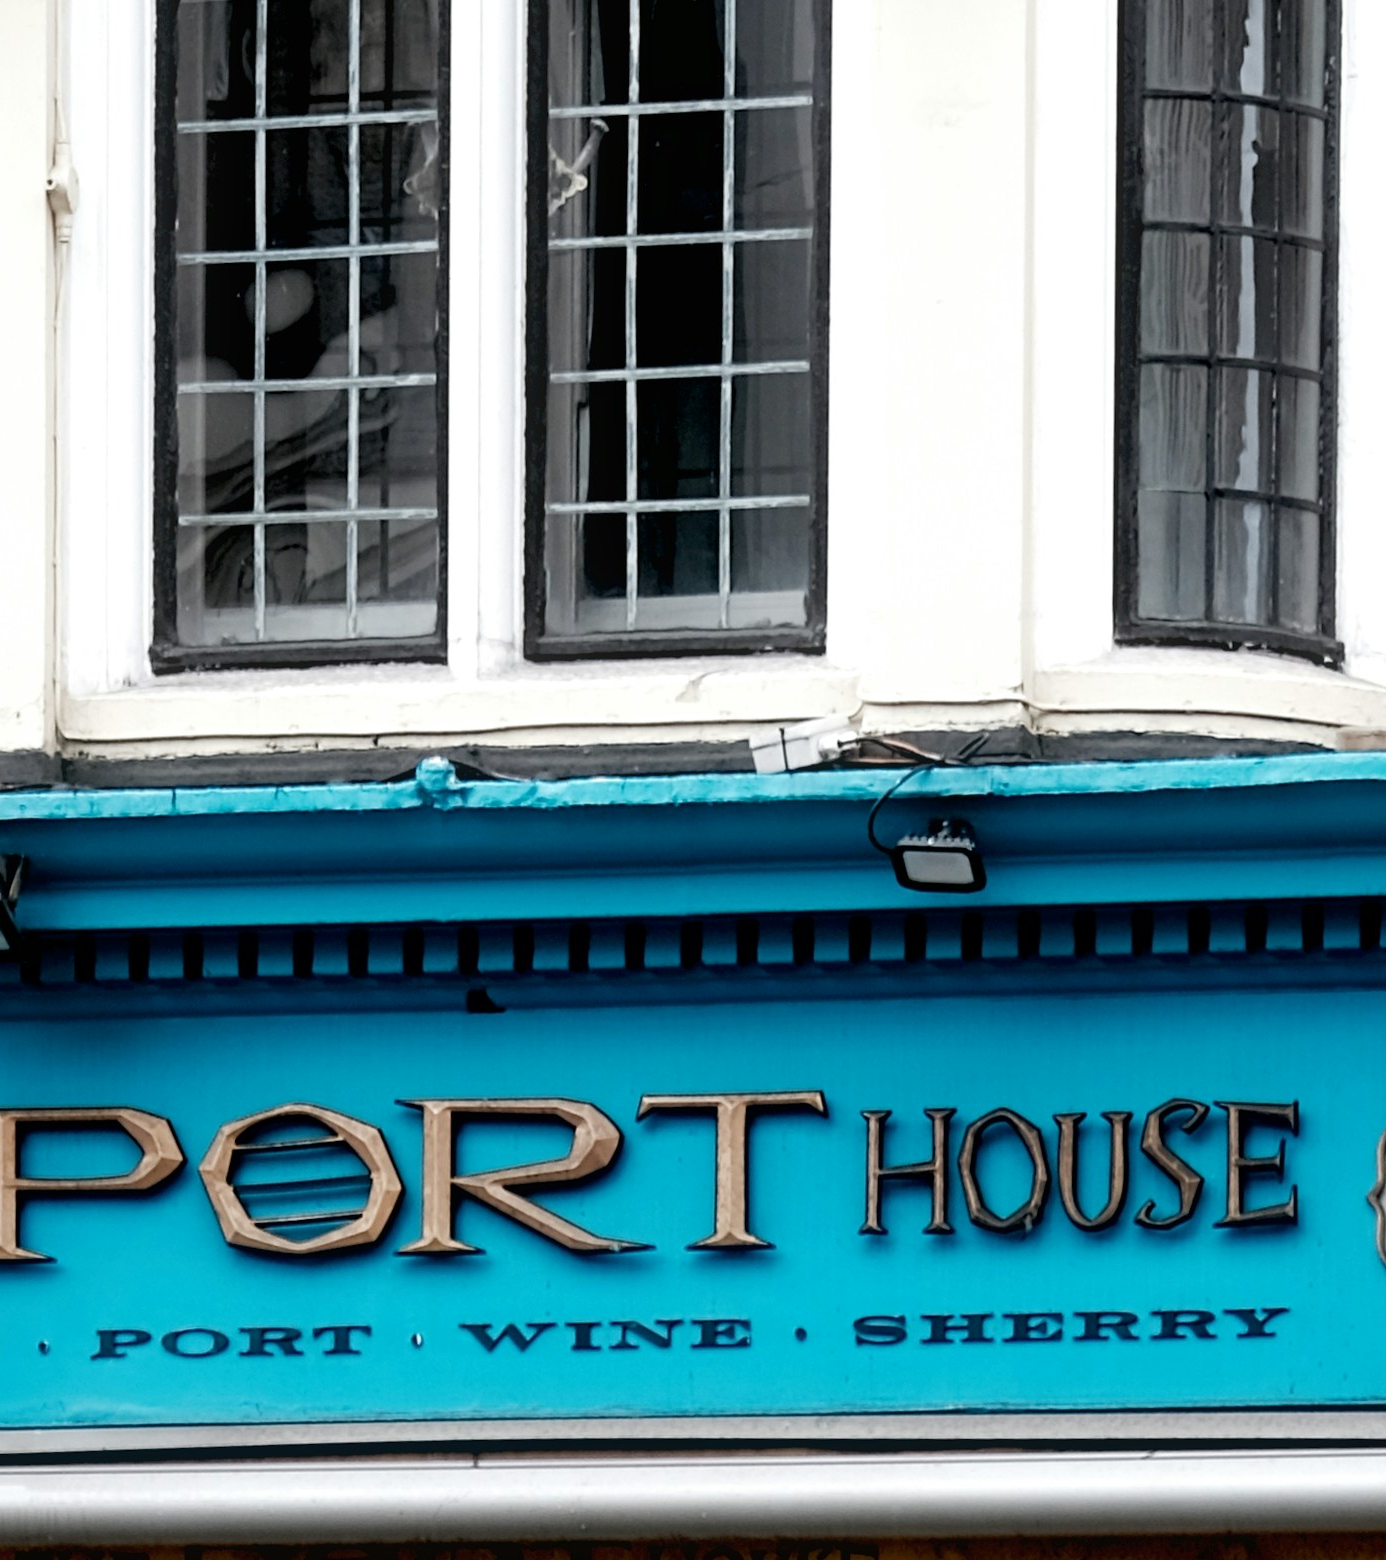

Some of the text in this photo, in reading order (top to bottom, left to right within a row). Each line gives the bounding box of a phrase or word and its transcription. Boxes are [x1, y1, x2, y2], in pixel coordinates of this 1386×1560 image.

[858, 1098, 1300, 1236] HOUSE
[90, 1325, 371, 1360] PORT
[459, 1318, 751, 1353] WINE
[854, 1307, 1290, 1346] SHERRY
